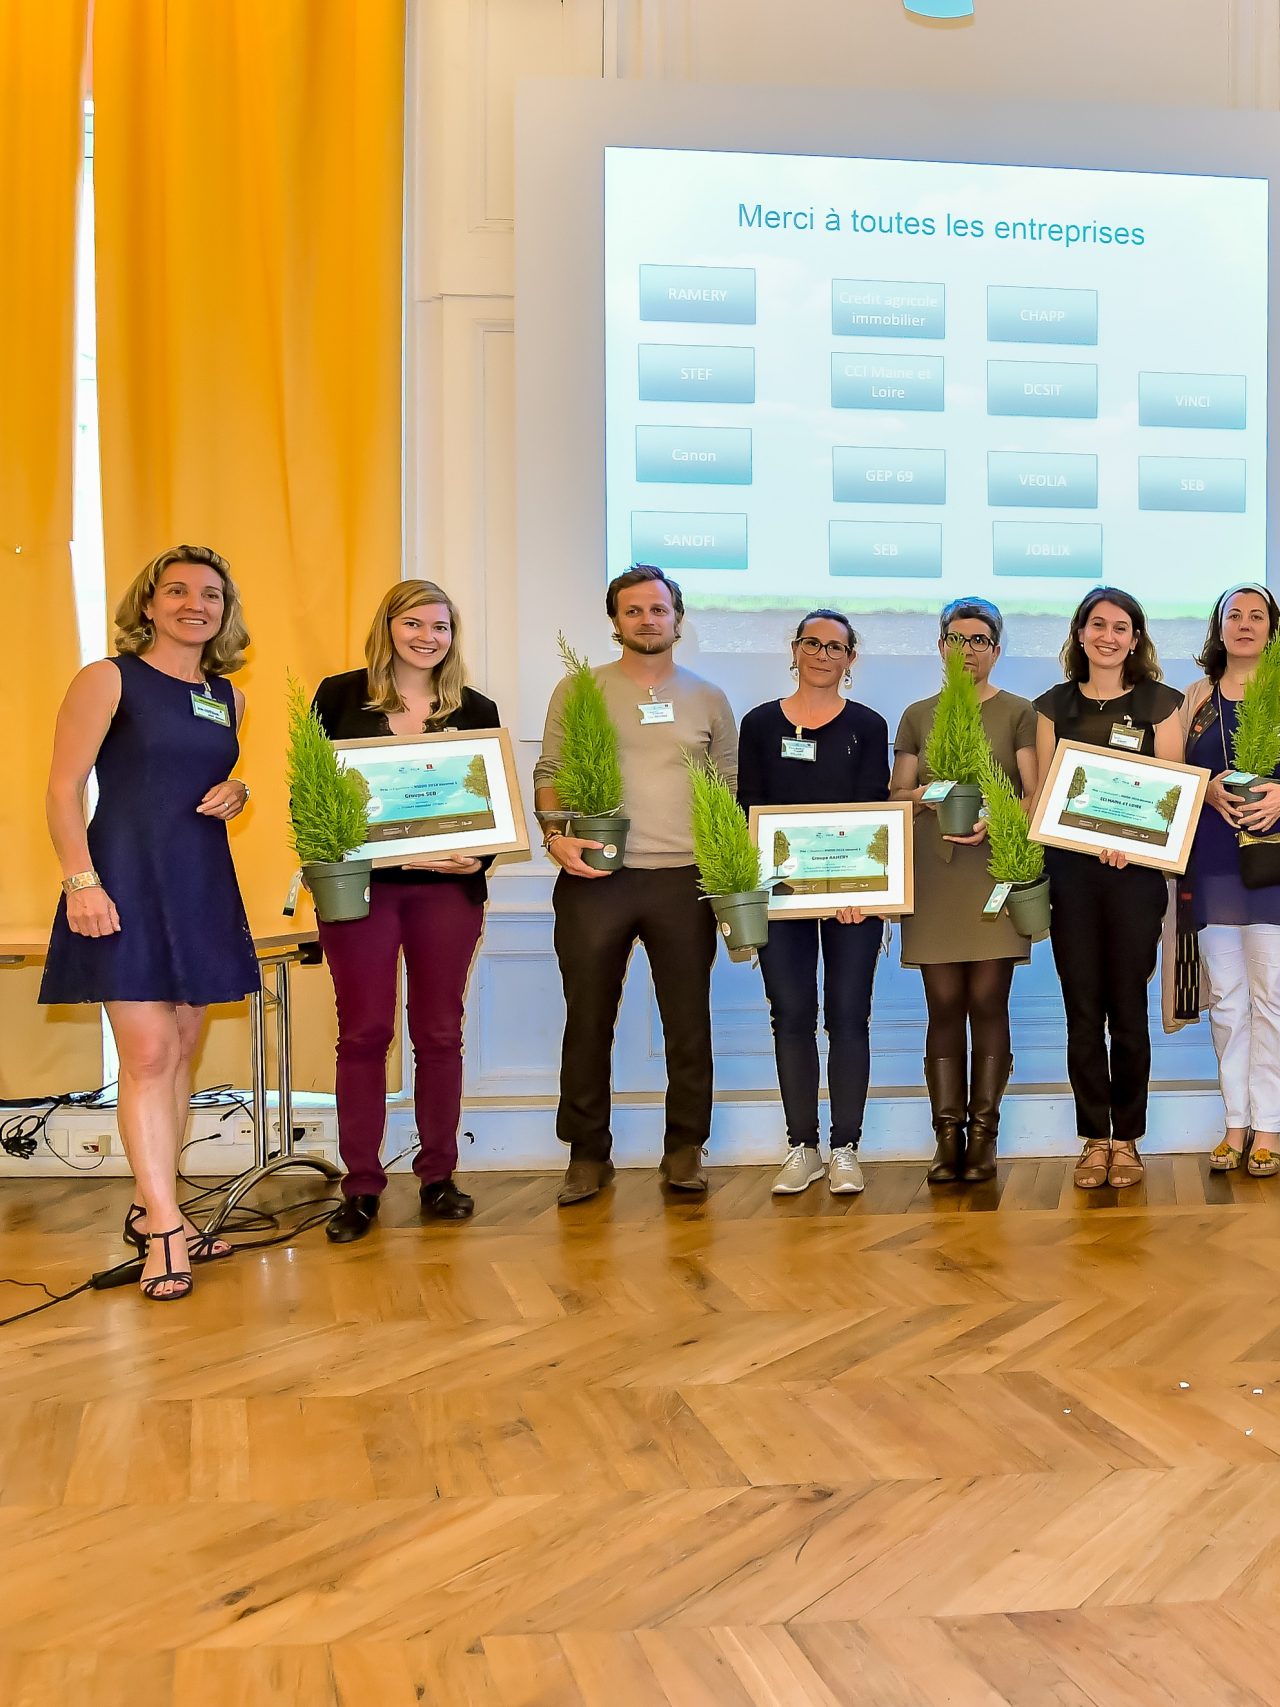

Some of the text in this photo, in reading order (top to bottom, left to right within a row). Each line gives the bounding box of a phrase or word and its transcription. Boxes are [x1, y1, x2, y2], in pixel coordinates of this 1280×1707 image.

[738, 203, 1145, 248] Merci à toutes les entreprises
[668, 287, 727, 303] RAMERY
[884, 293, 938, 311] agricole
[851, 312, 926, 327] immobilier
[1020, 309, 1065, 322] CHAPP
[680, 367, 713, 381] STEF
[844, 364, 932, 380] CCI Maine et
[871, 385, 905, 399] Loire
[1023, 383, 1063, 396] DCSIT
[1175, 395, 1210, 408] VINCI
[671, 448, 717, 462] Canon
[865, 470, 913, 483] GEP 69
[1019, 473, 1067, 487] VEOLIA
[1180, 478, 1205, 492] SEB
[663, 534, 715, 548] SANOFI
[872, 543, 898, 556] SEB
